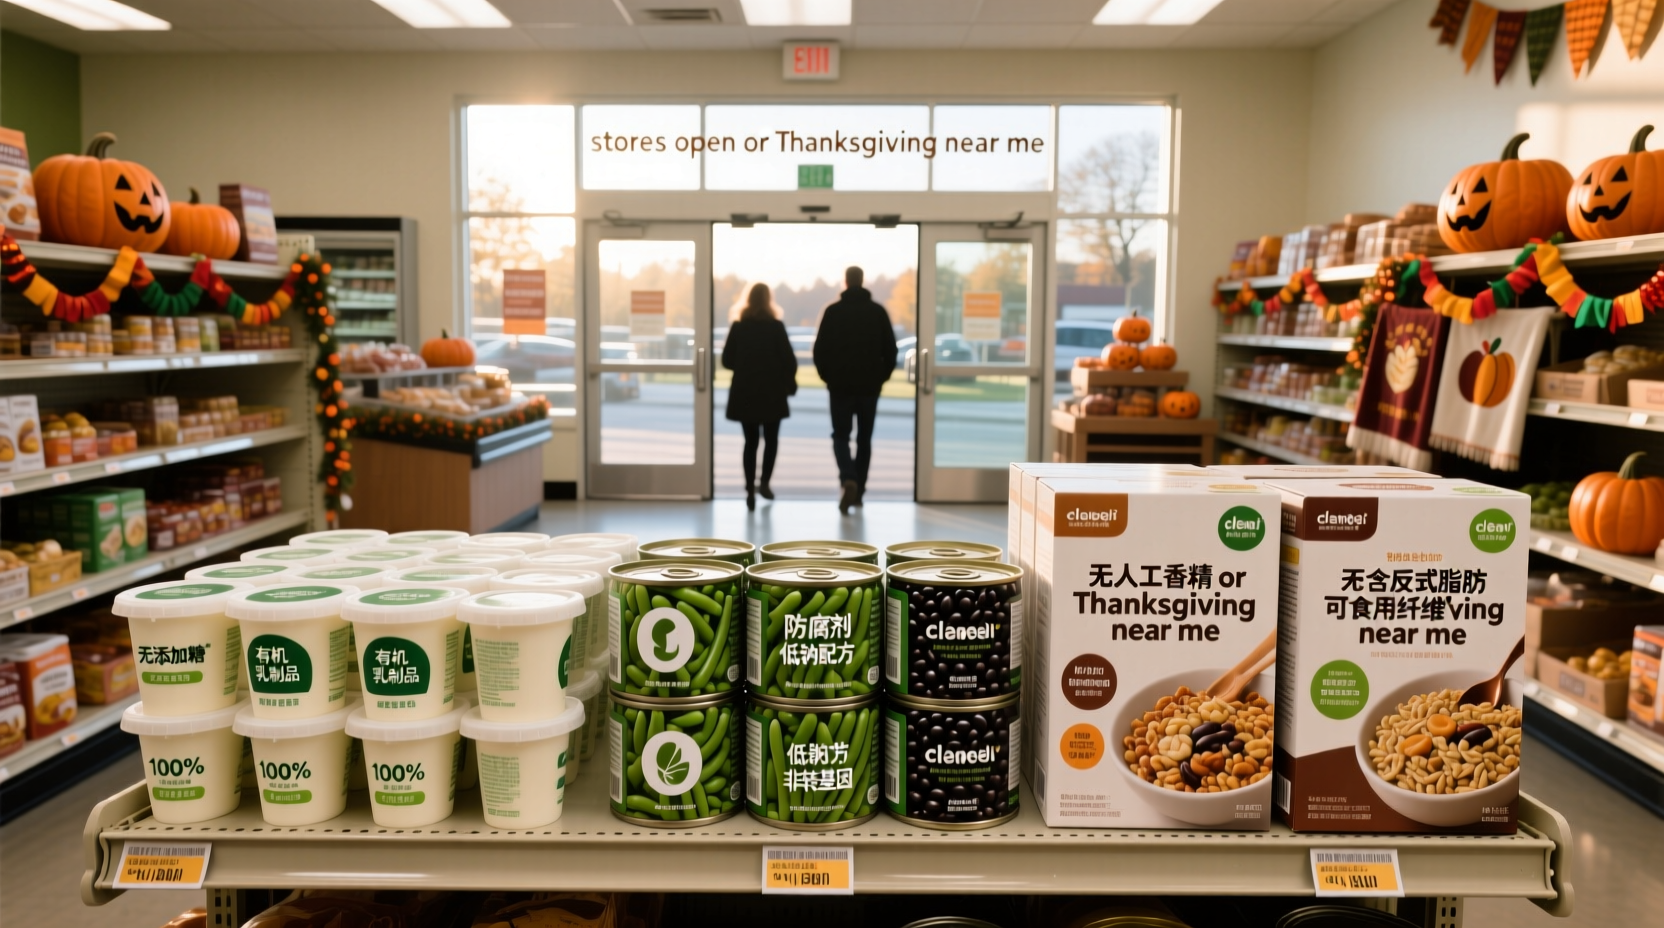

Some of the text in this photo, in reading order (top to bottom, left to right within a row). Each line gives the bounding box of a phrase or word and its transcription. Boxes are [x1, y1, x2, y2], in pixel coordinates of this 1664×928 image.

[591, 130, 1044, 159] stores open or Thanksgiving near me
[1089, 563, 1247, 590] 无人工香精 or
[1341, 567, 1488, 595] 无含反式脂肪
[1073, 591, 1256, 622] Thanksgiving
[1111, 623, 1220, 641] near me
[1359, 626, 1467, 645] near me
[148, 756, 205, 777] 100%
[259, 760, 312, 781] 100%
[371, 761, 425, 783] 100%
